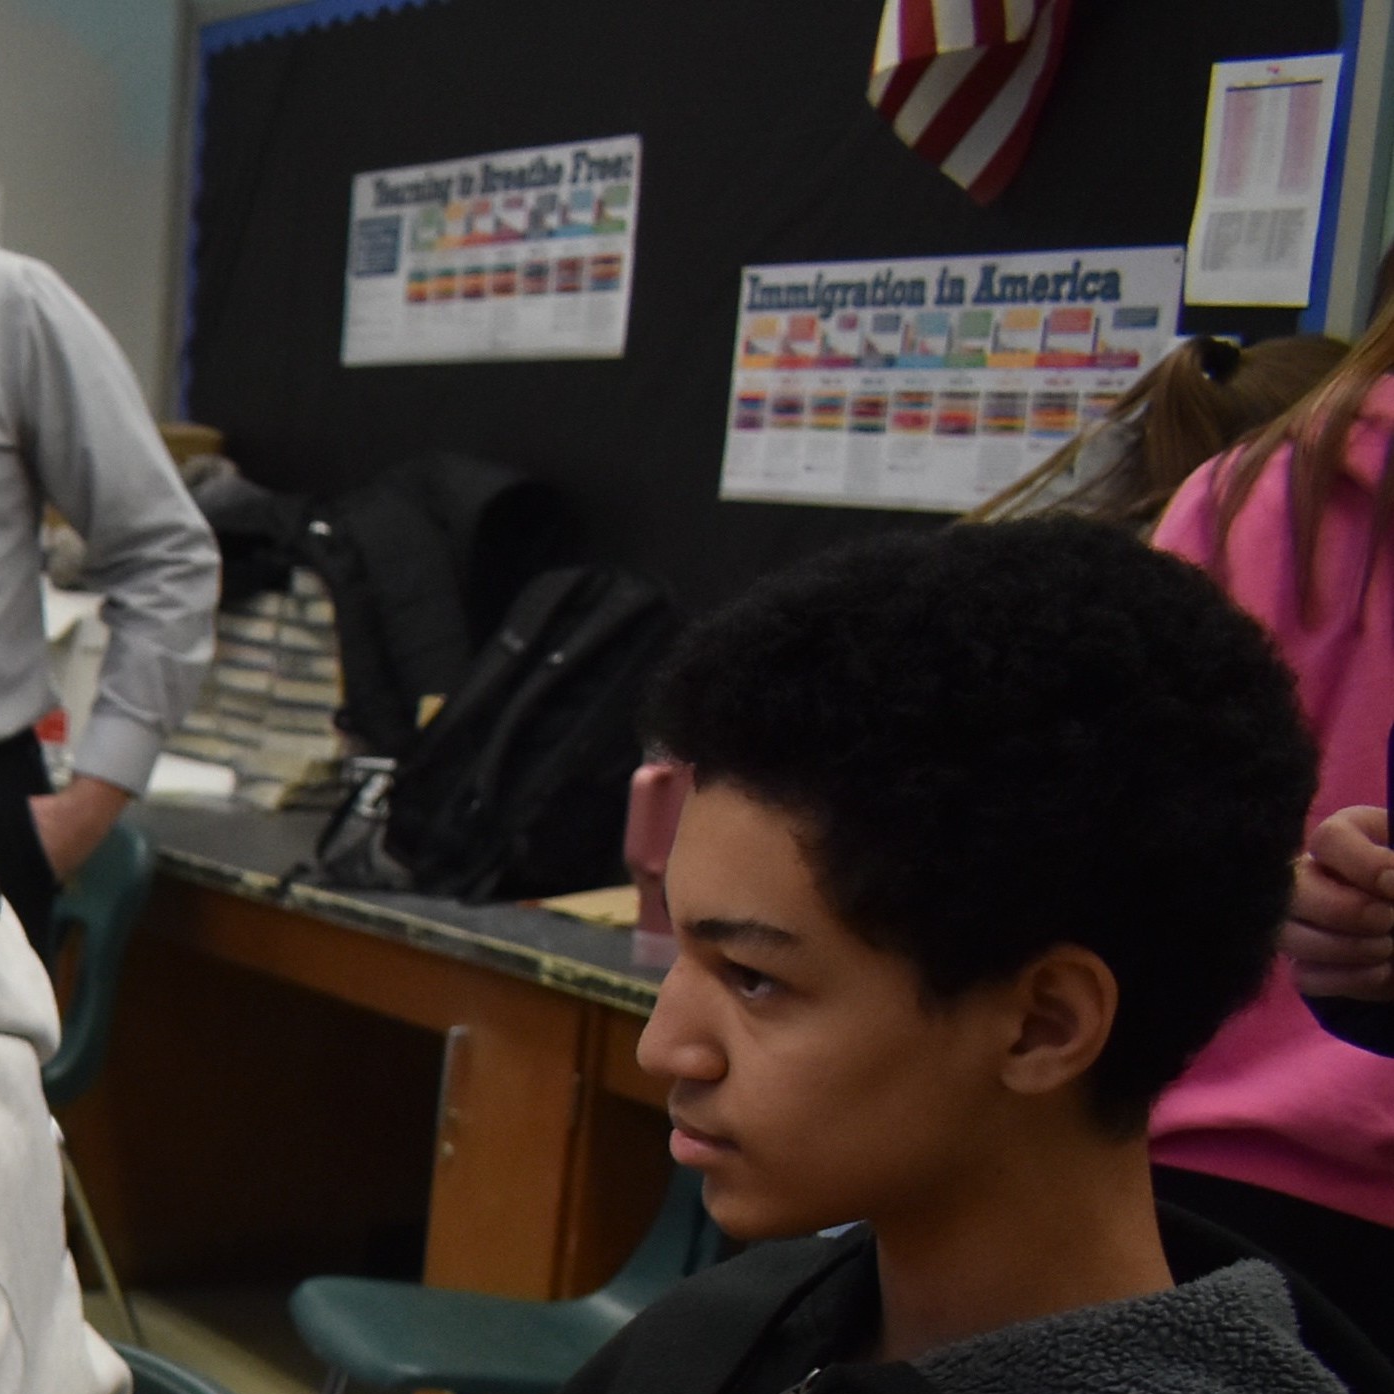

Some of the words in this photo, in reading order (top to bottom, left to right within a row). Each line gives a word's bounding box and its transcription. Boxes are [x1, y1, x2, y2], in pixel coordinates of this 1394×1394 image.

[480, 157, 564, 194] Breathe
[746, 270, 927, 319] Immigration
[935, 265, 965, 306] in
[972, 259, 1122, 305] America
